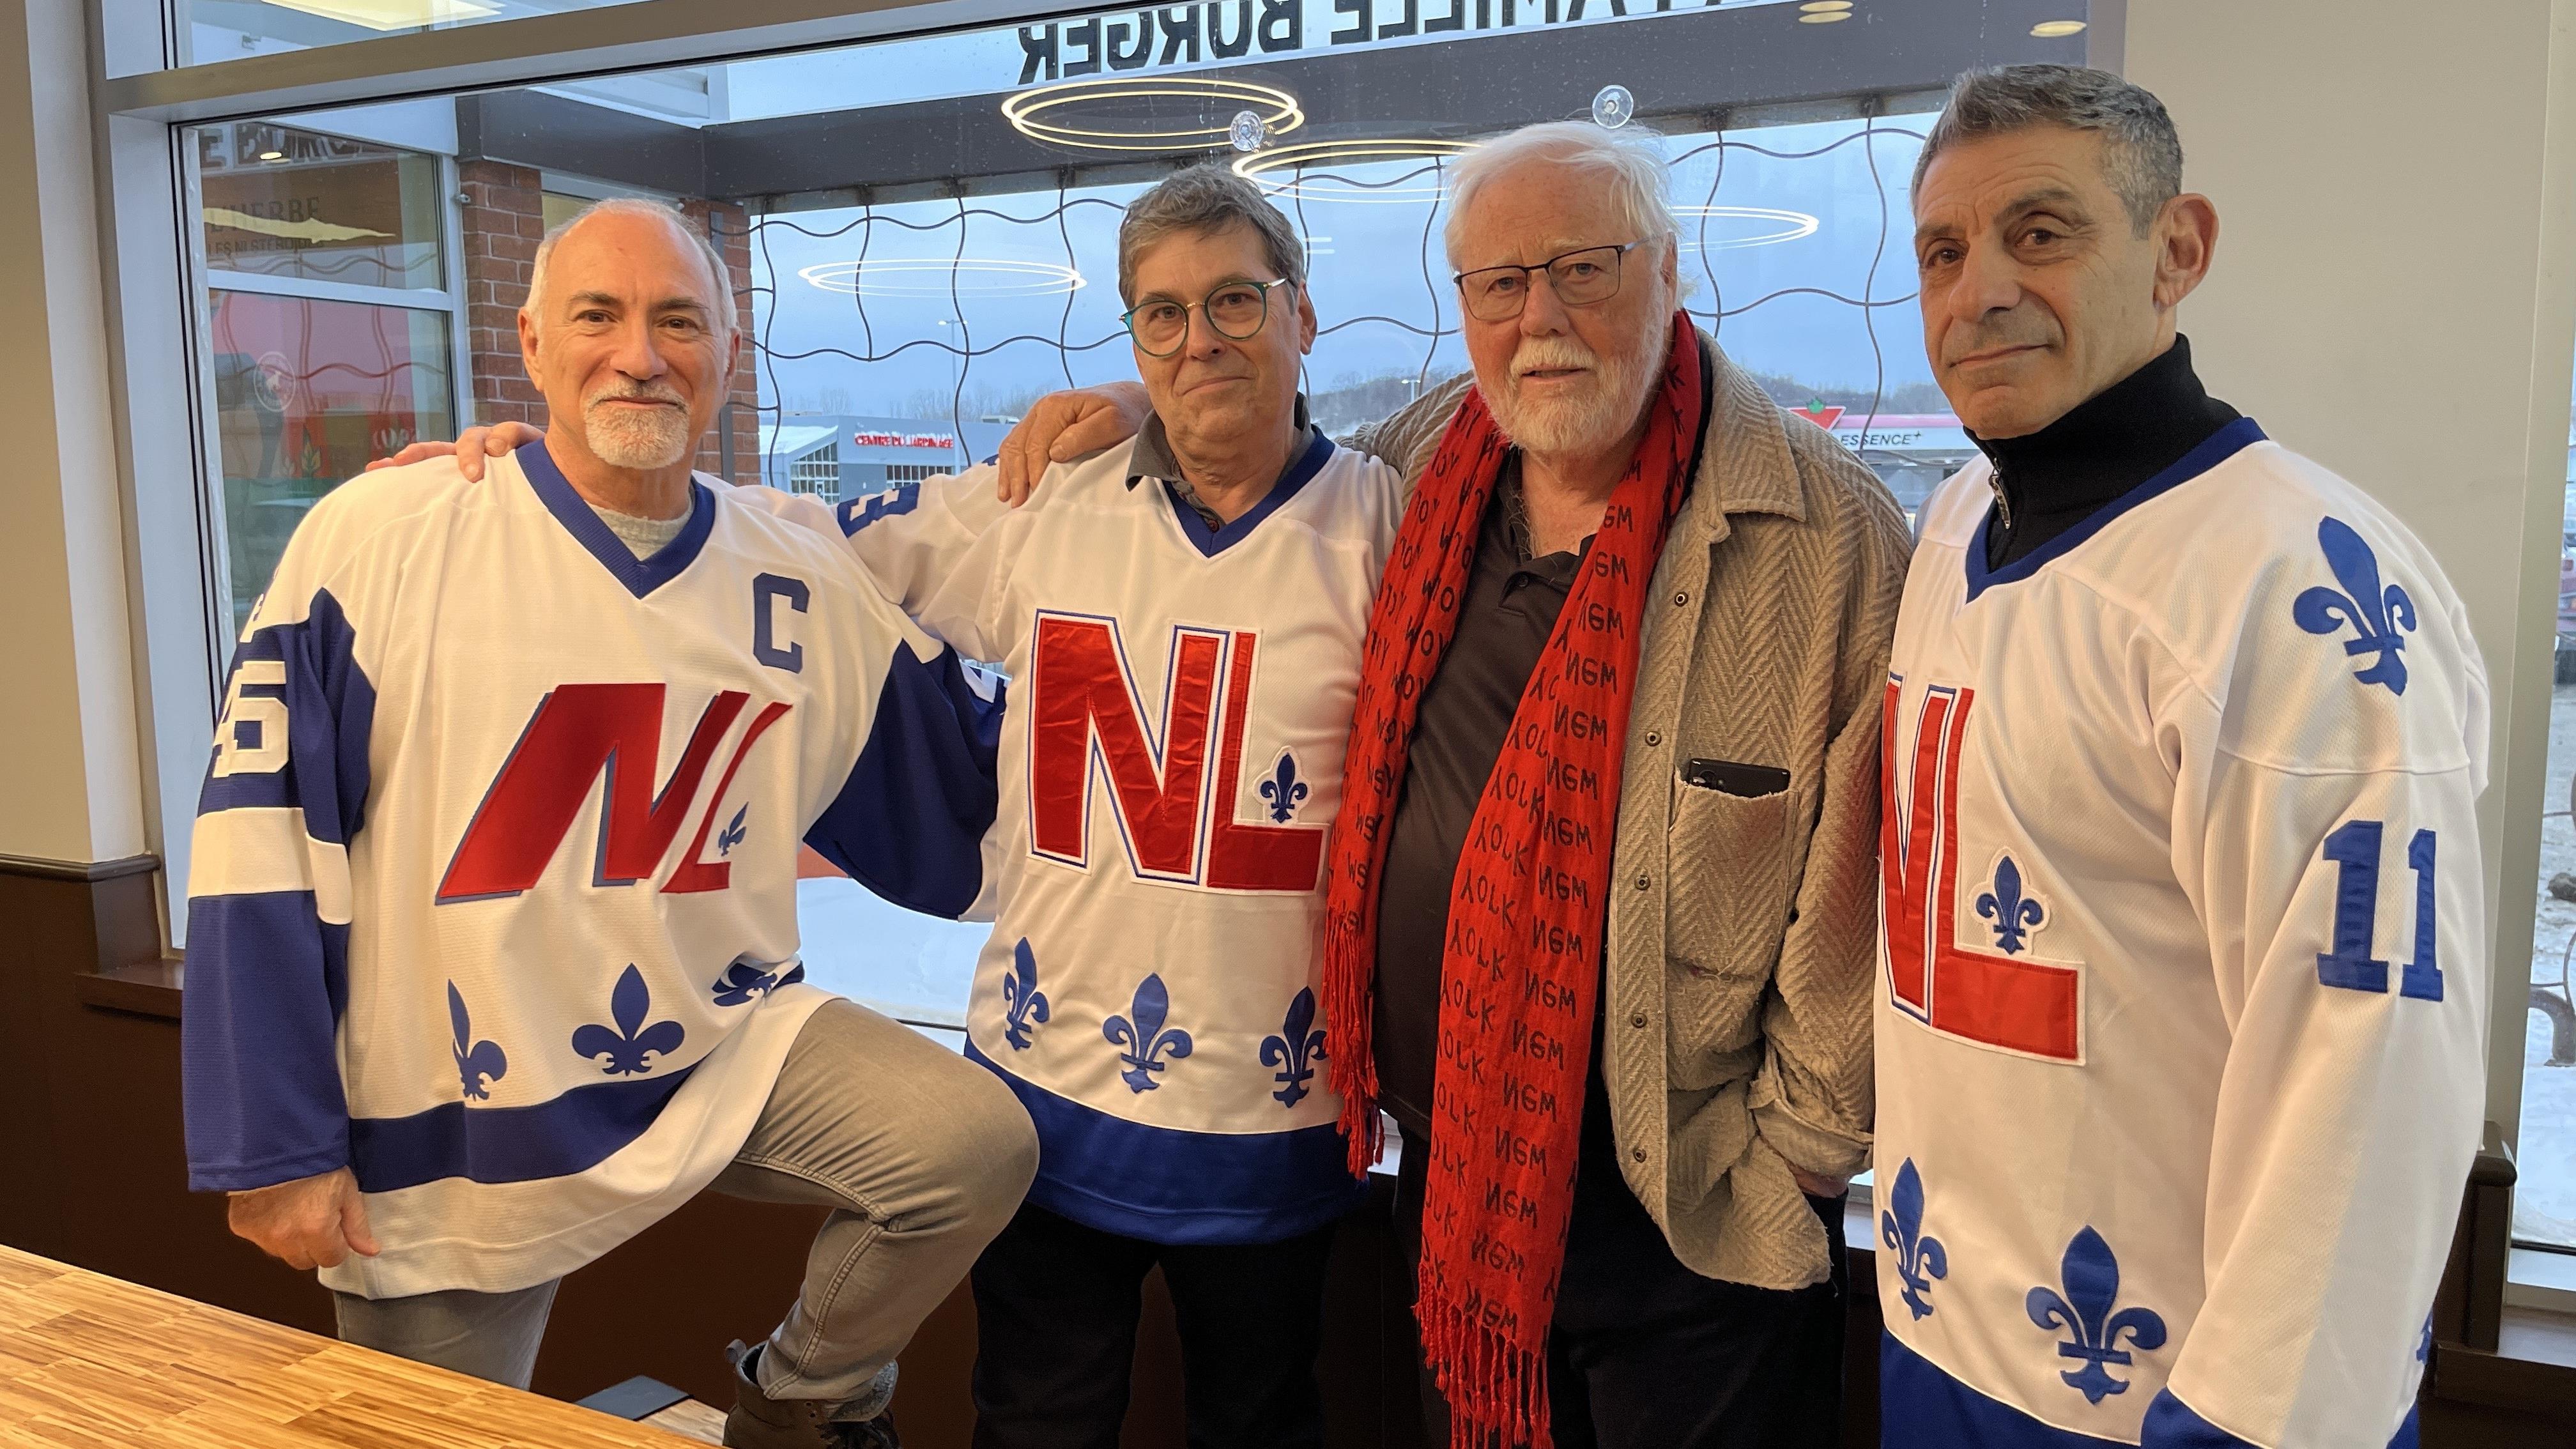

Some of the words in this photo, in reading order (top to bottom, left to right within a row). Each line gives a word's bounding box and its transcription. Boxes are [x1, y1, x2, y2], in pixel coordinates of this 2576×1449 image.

[753, 571, 809, 673] C
[436, 682, 792, 905] NL
[1027, 609, 1323, 891] NL
[2316, 819, 2444, 1002] 11
